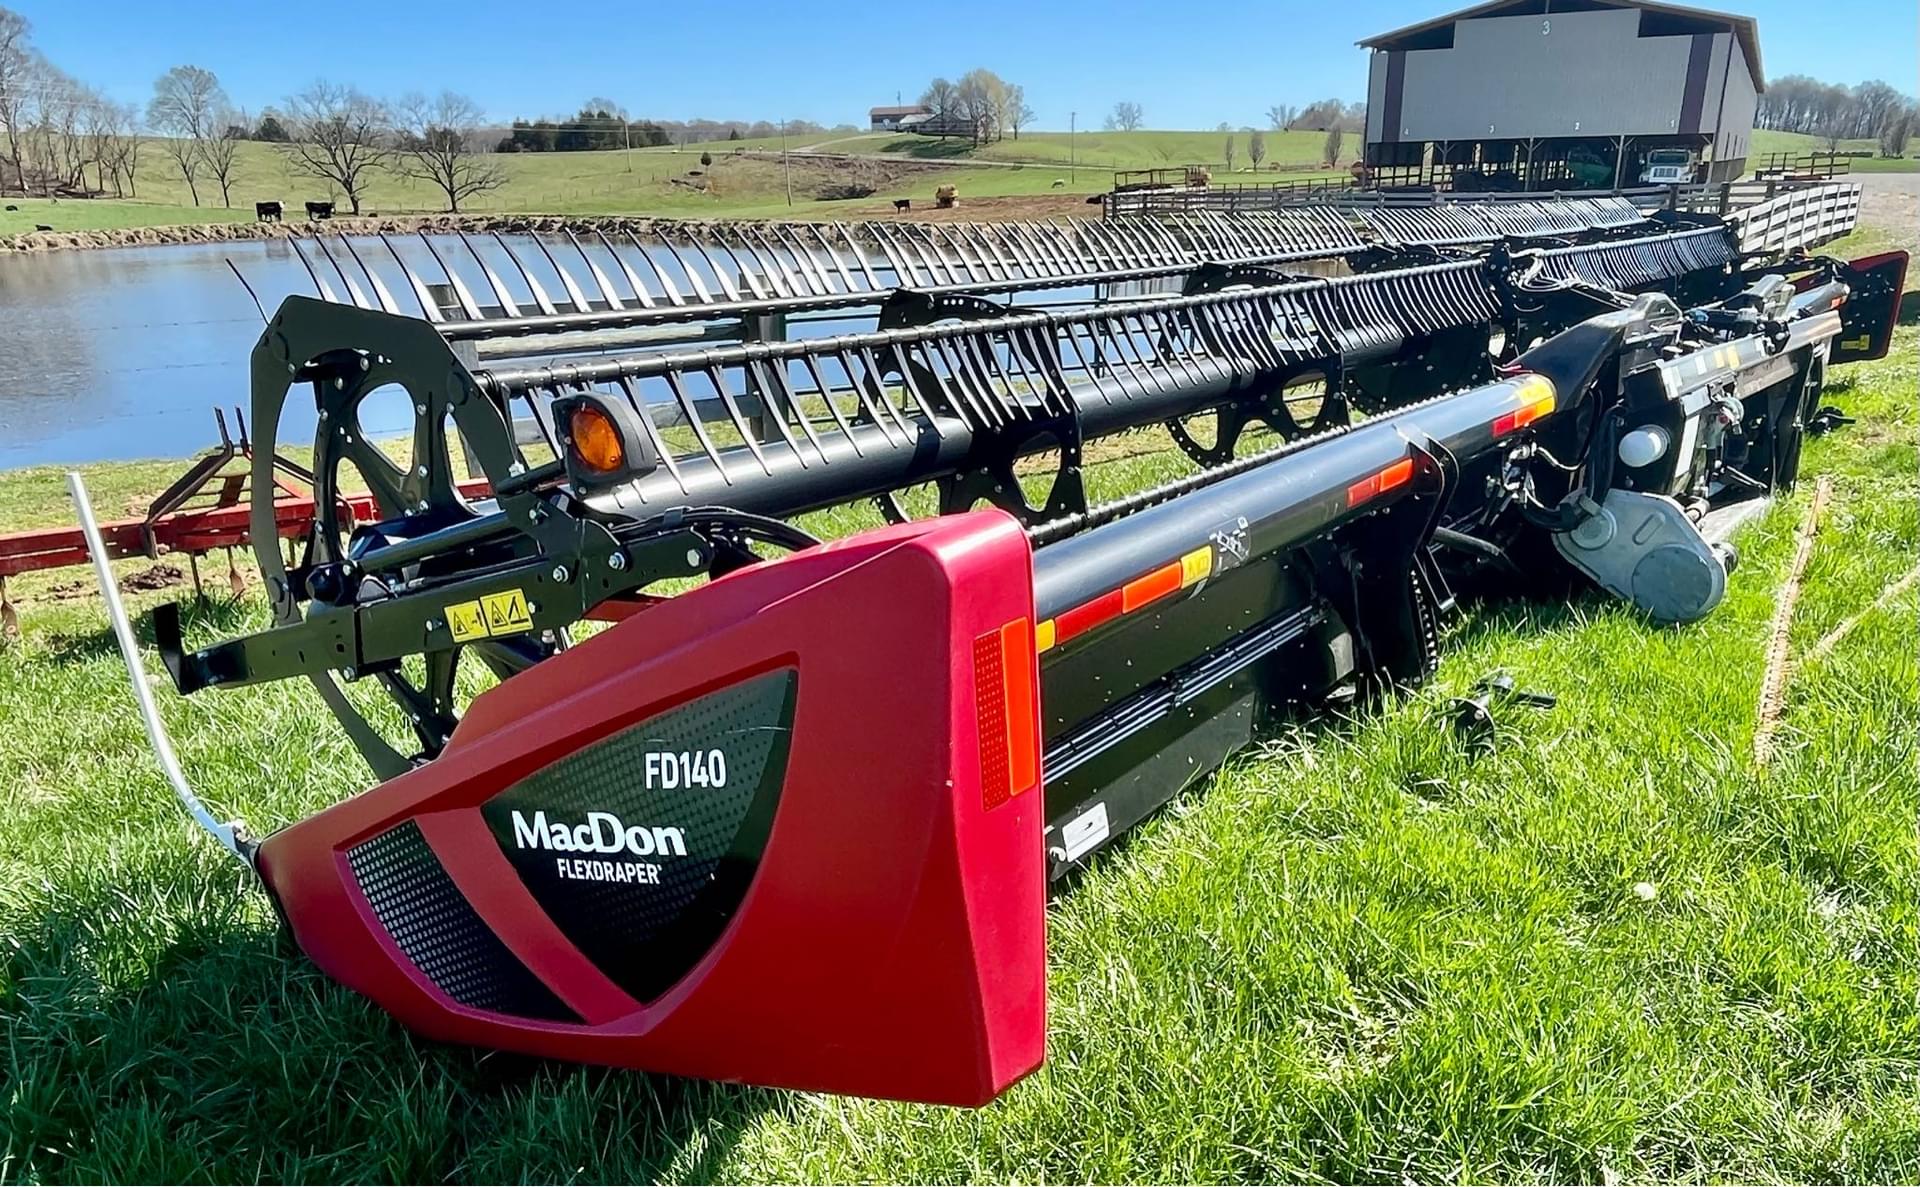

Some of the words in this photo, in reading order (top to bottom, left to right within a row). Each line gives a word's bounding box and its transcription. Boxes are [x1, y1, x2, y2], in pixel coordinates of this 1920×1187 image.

[1542, 20, 1551, 35] 3
[645, 748, 727, 790] FD140
[511, 810, 688, 856] MacDon
[556, 858, 662, 885] FLEXDRAPER
